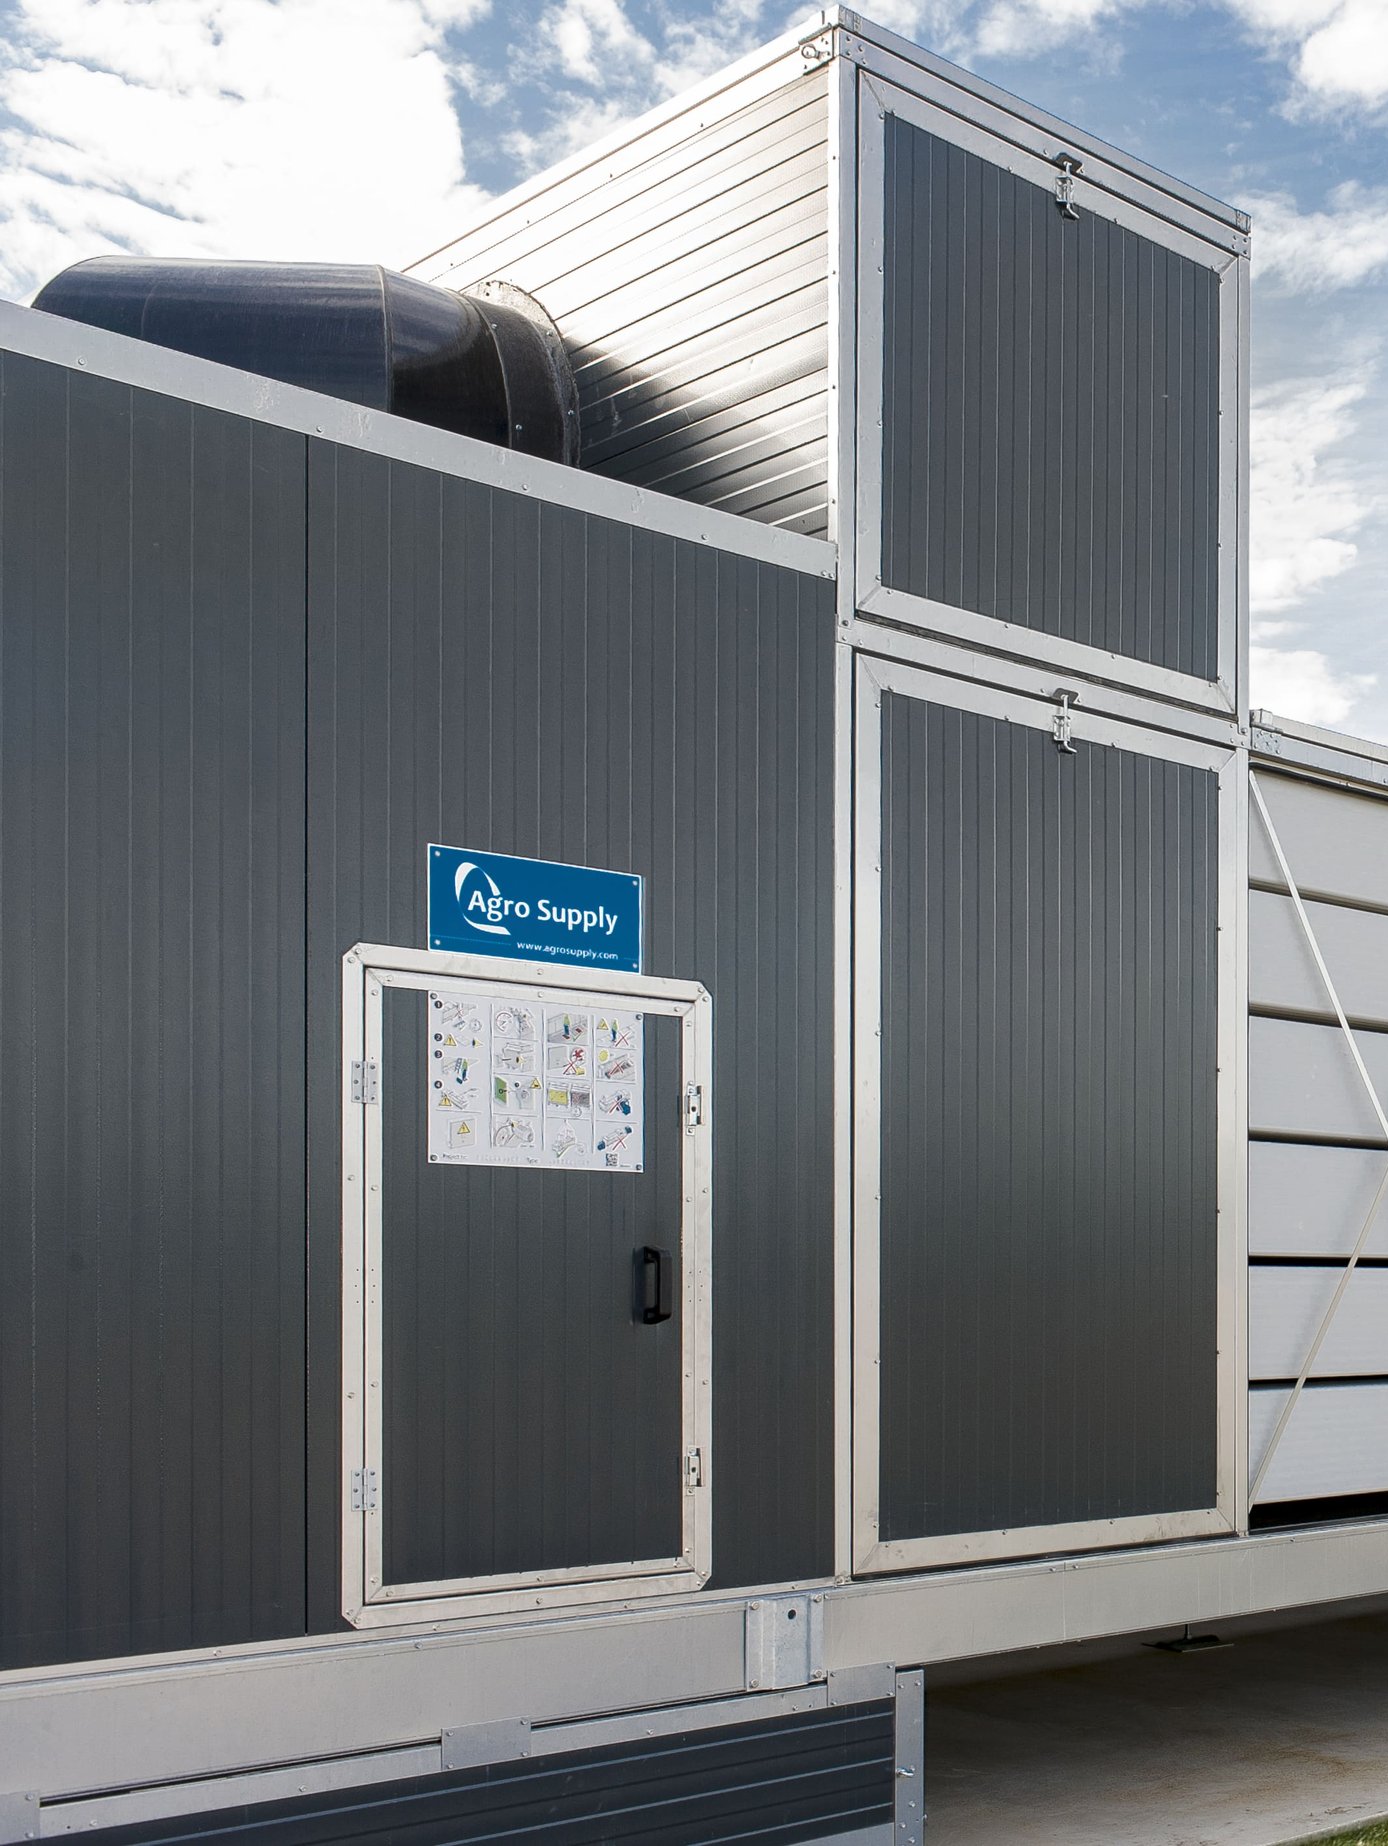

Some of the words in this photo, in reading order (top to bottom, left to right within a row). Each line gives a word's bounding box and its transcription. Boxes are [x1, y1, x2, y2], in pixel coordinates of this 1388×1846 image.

[467, 890, 531, 922] Agro
[537, 899, 618, 936] Supply
[516, 941, 619, 961] www.agrosupply.com
